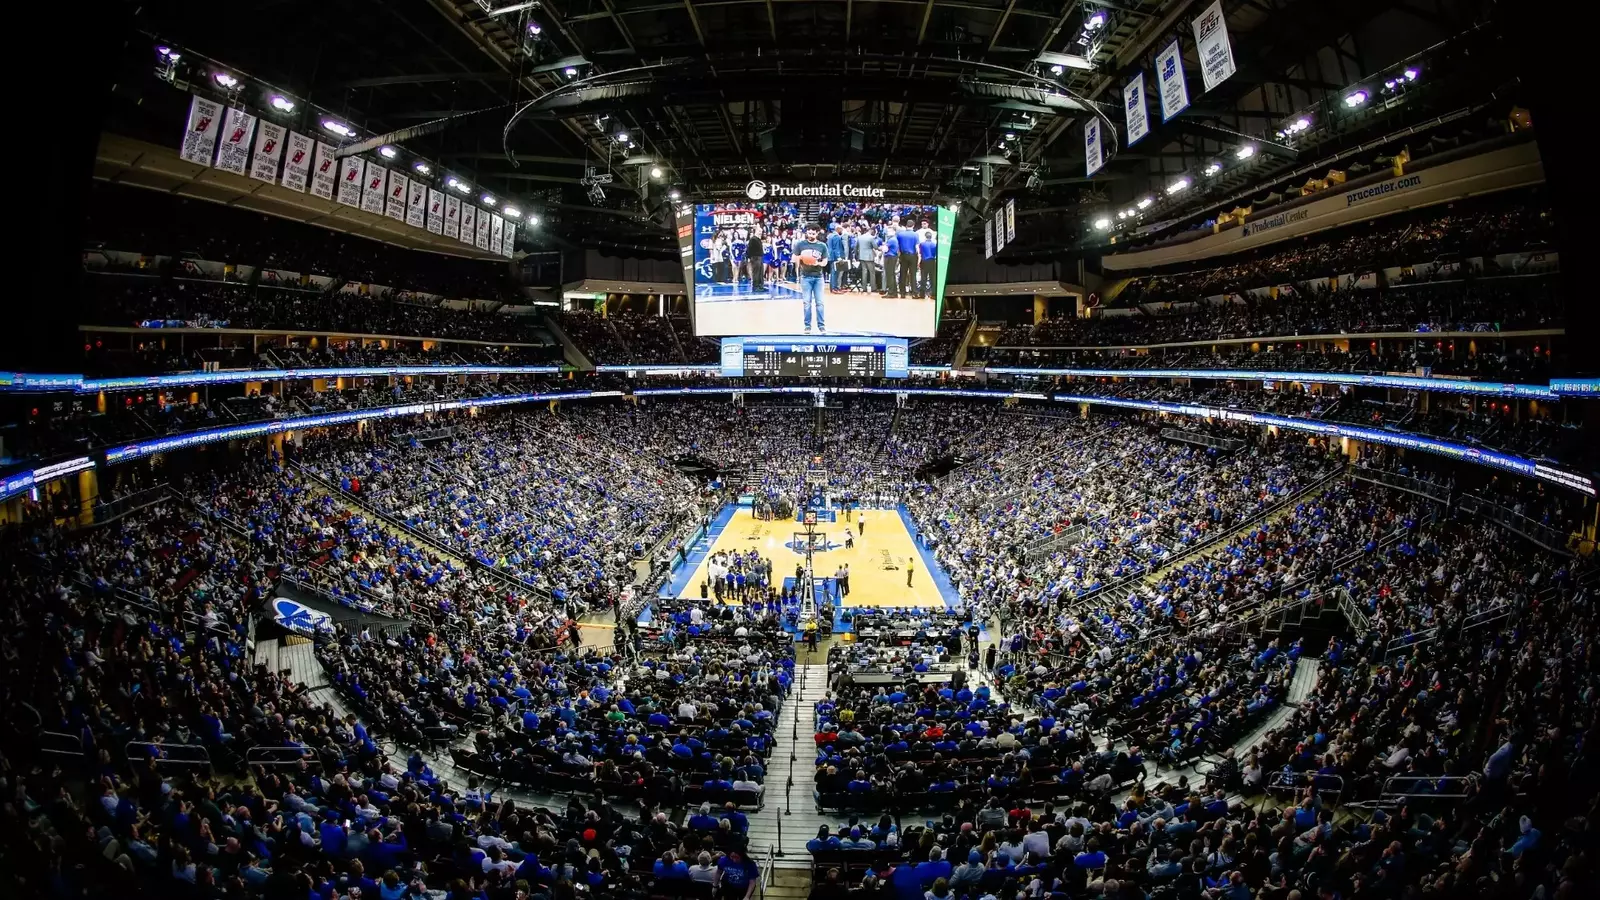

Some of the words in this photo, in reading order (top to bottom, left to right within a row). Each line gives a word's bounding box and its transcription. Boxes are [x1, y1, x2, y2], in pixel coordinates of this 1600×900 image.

[1199, 16, 1220, 38] EAST
[1201, 11, 1215, 29] BIG
[770, 184, 841, 196] Prudential
[842, 185, 885, 198] Center
[1347, 175, 1421, 206] prucenter.com
[713, 213, 754, 226] NIELSEN
[1251, 214, 1286, 234] Prudential
[1285, 208, 1309, 225] Center
[786, 356, 797, 364] 44
